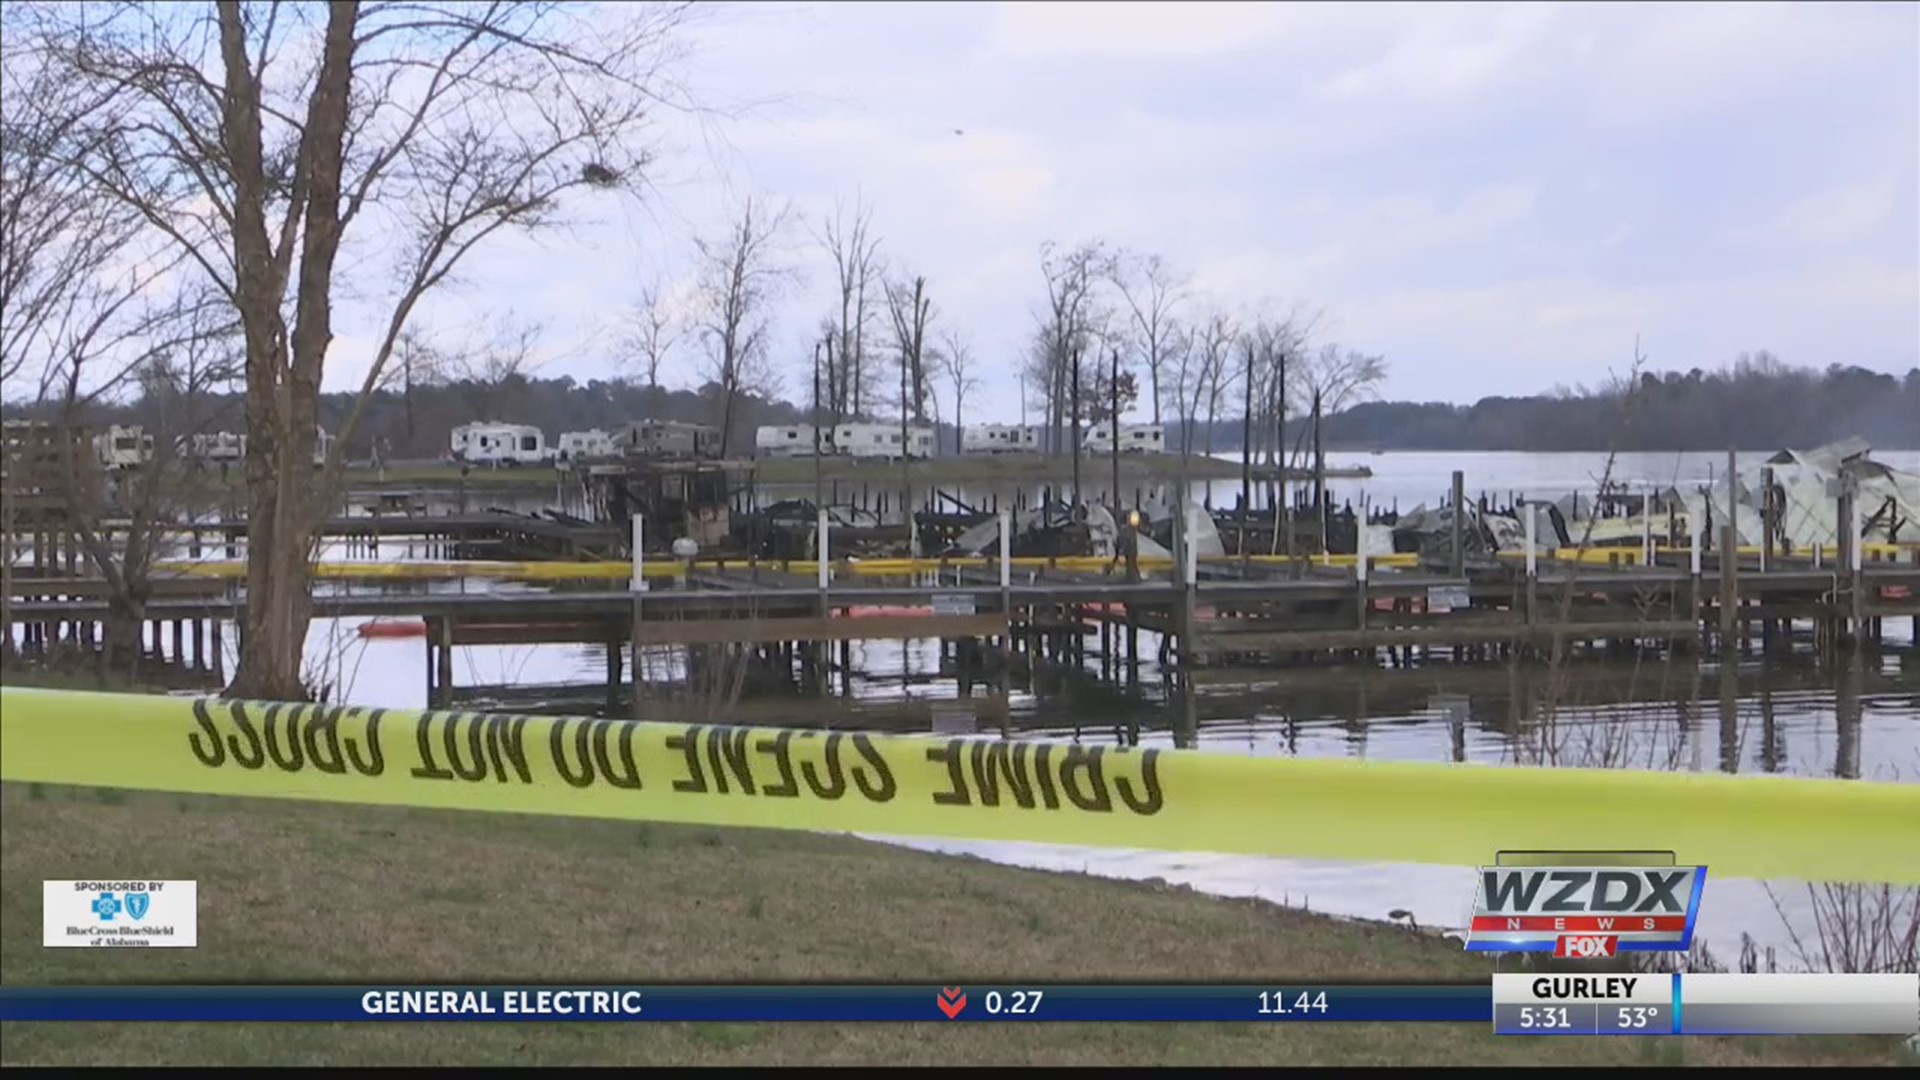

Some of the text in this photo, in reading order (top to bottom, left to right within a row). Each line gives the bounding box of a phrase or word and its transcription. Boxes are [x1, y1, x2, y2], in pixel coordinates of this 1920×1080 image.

[189, 700, 1164, 816] CRIME SCENE DO NOT CROSS
